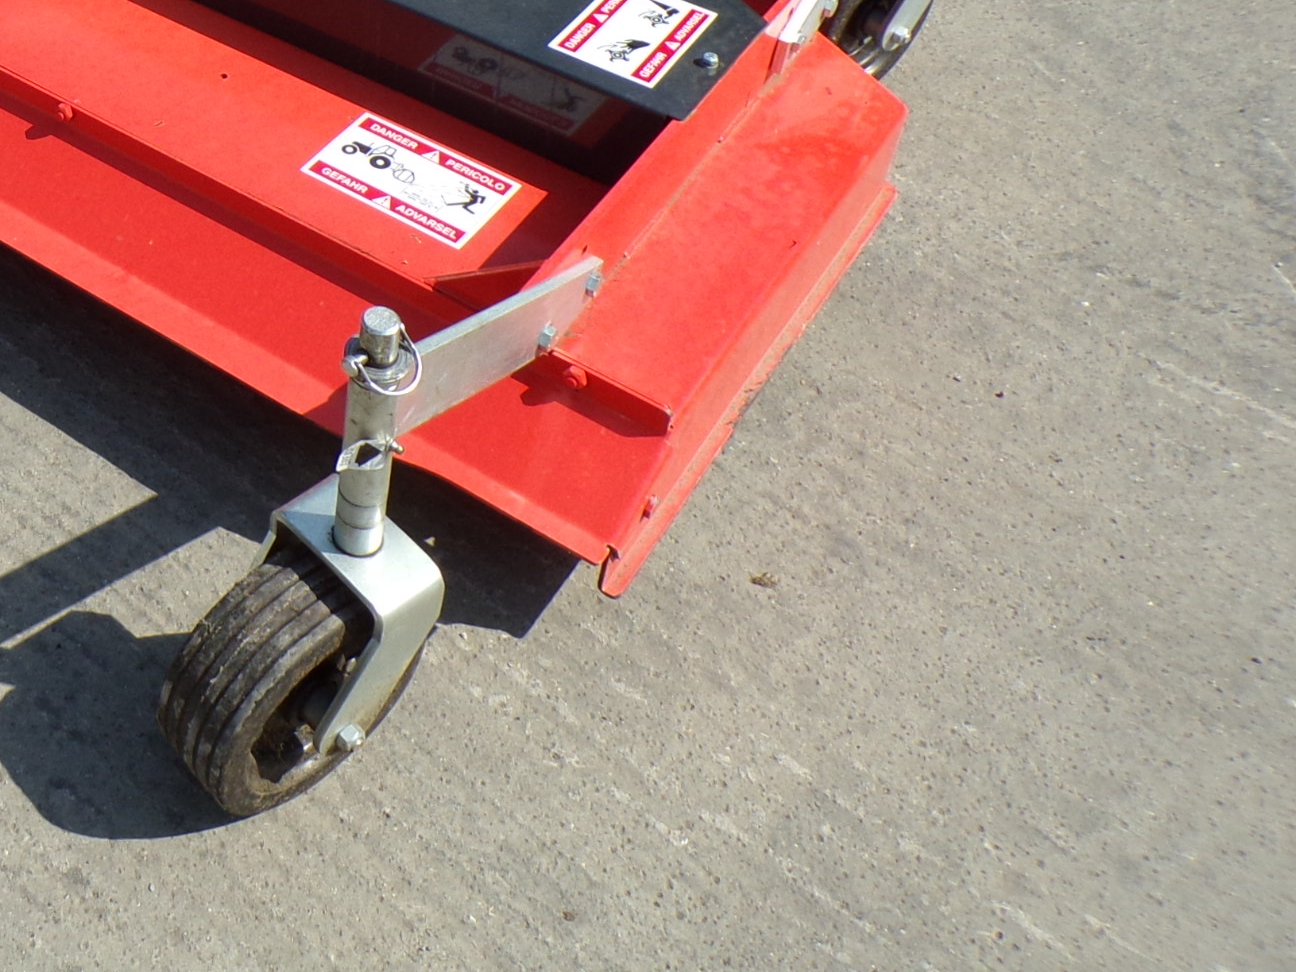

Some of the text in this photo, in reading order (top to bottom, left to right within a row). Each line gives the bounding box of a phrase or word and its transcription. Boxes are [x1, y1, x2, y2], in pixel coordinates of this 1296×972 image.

[564, 22, 596, 50] DANGER
[639, 11, 706, 78] GEFAHR ADVARSEL
[369, 122, 506, 192] DANGER PERICOLO
[321, 166, 458, 240] GEFAHR ADVARSEL
